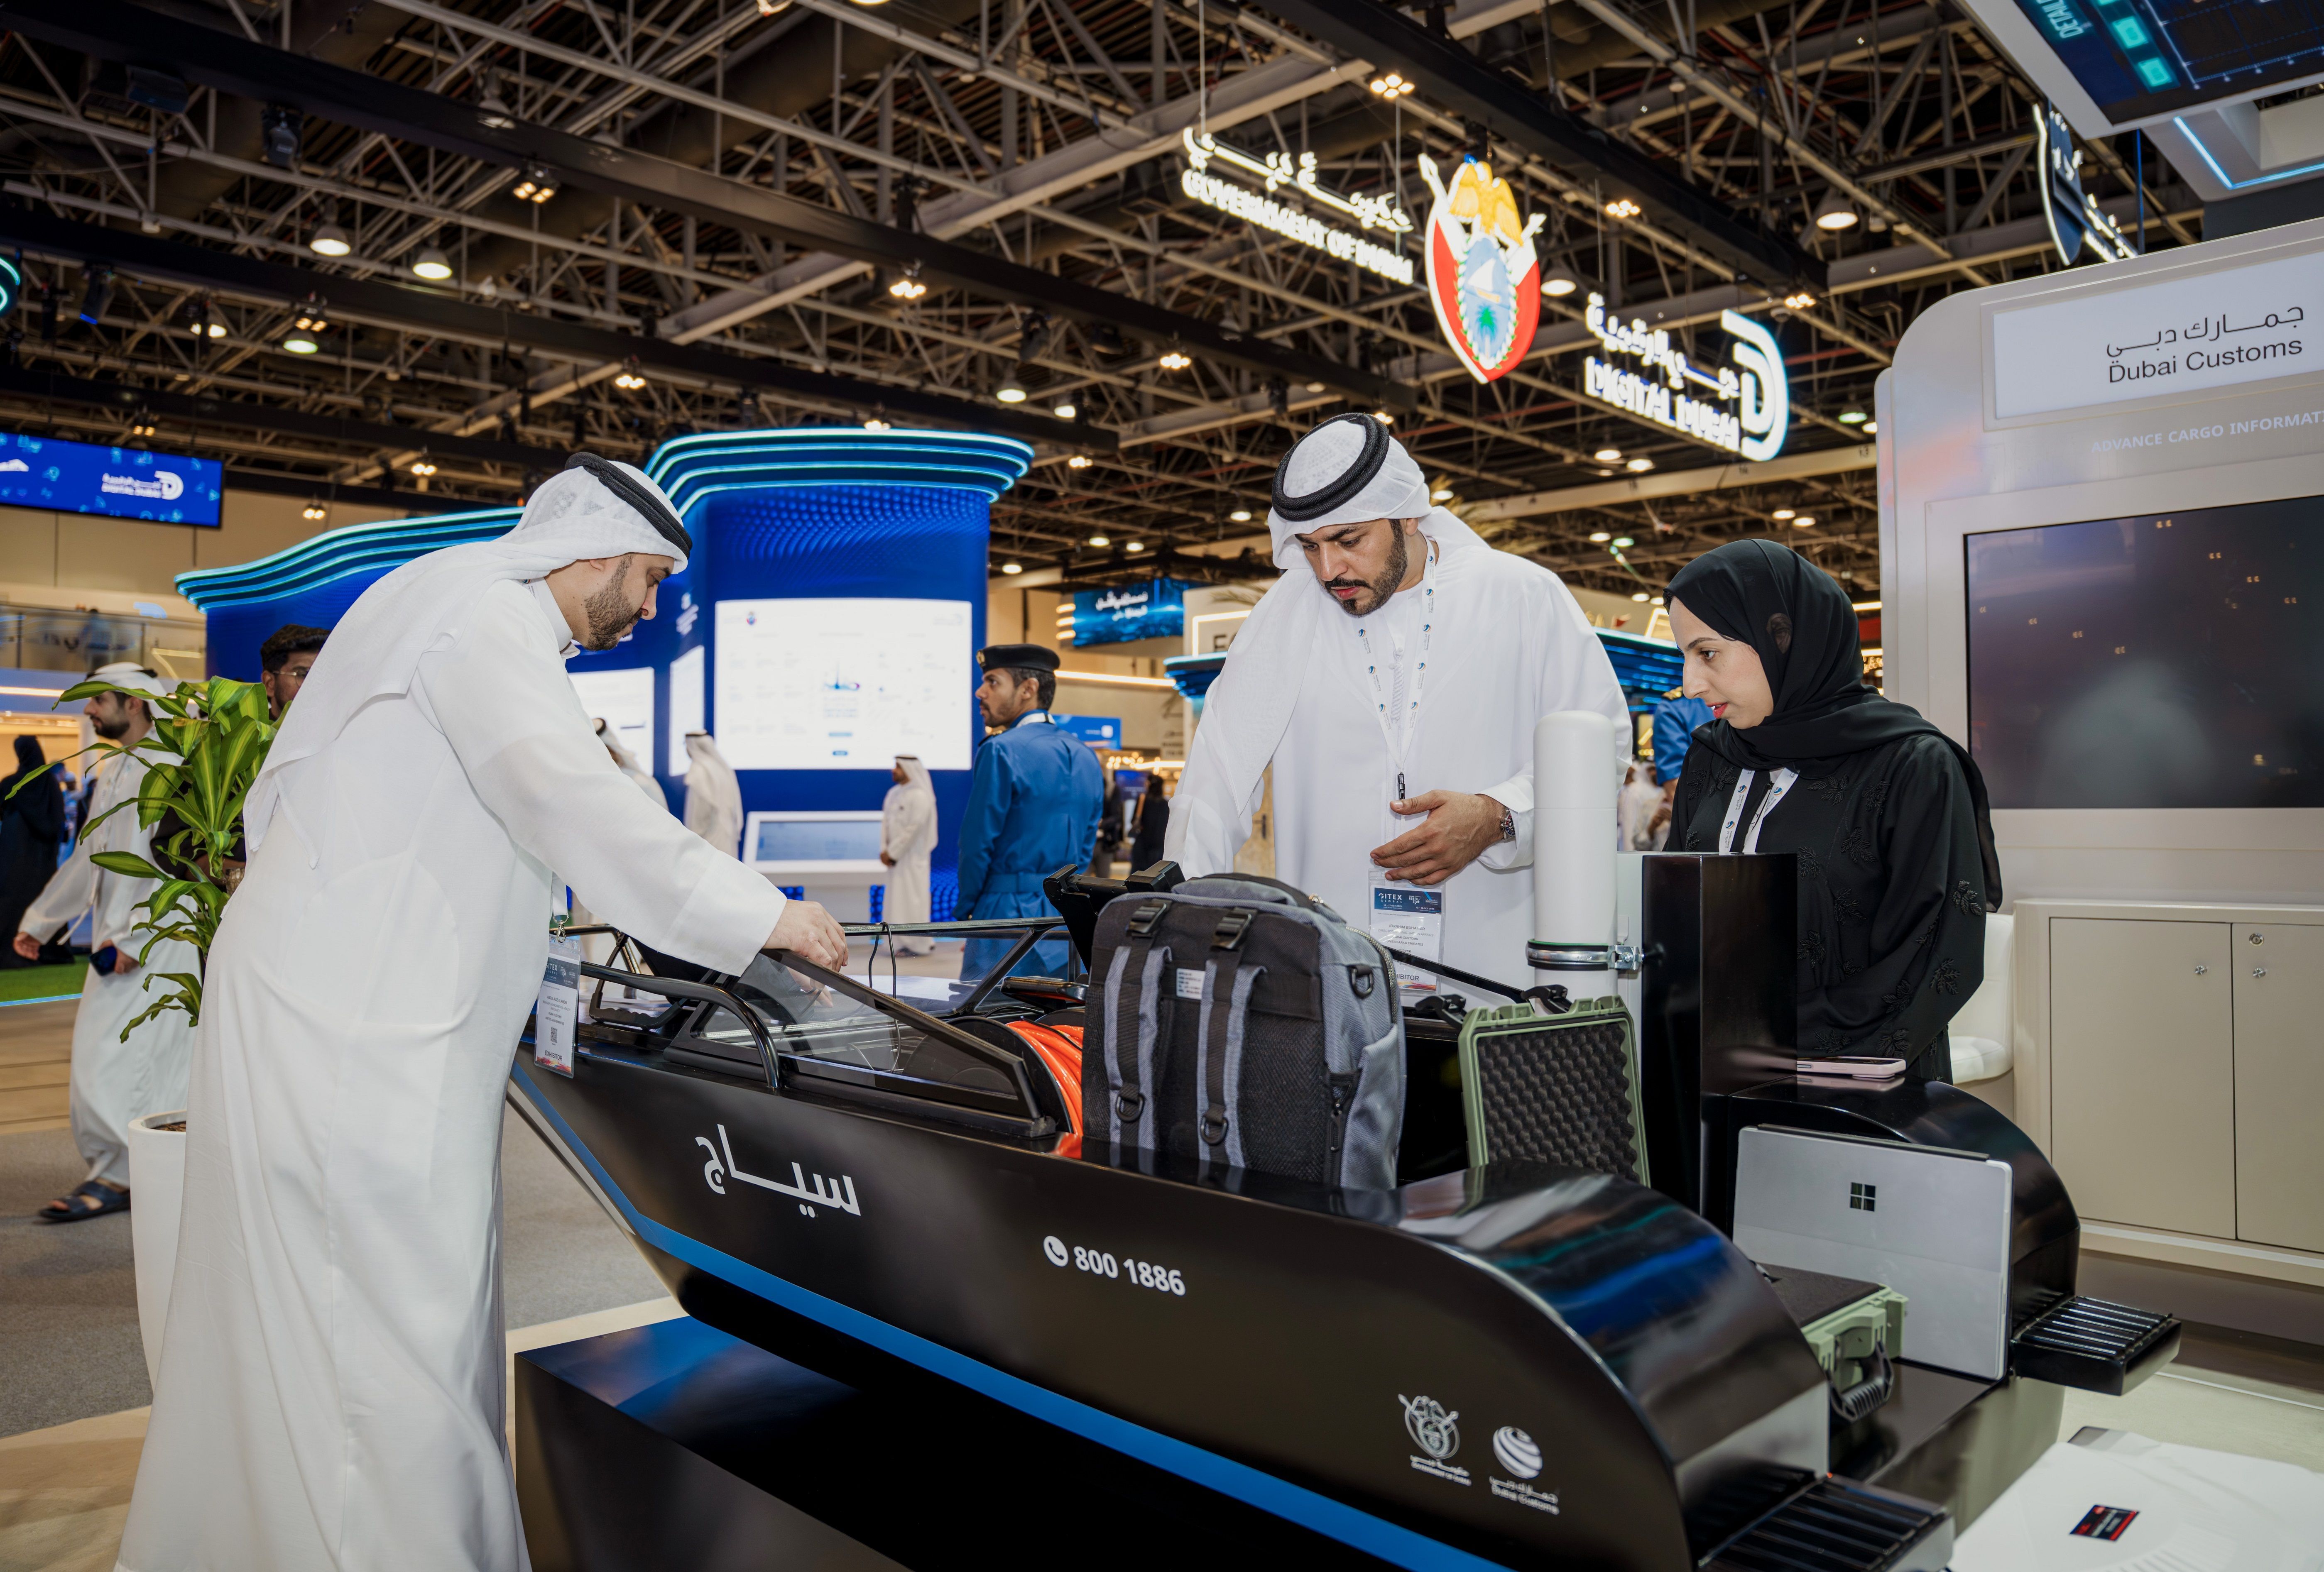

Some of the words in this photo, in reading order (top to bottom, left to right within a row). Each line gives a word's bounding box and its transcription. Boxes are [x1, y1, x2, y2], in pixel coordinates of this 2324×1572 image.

[1181, 168, 1329, 250] GOVERNMENT
[1326, 229, 1357, 261] OF
[2184, 306, 2304, 342] جمارك
[2106, 328, 2177, 365] دبي
[2109, 355, 2177, 383] Dubai
[2186, 339, 2303, 371] Customs
[1584, 355, 1676, 428] DIGITAL
[1675, 394, 1741, 452] DUBAI
[2091, 433, 2162, 453] ADVANCE
[2168, 424, 2224, 443] CARGO
[545, 1050, 563, 1061] EXHIBITOR
[695, 1123, 862, 1218] سياج
[1073, 1246, 1119, 1279] 800
[1123, 1258, 1186, 1296] 1886
